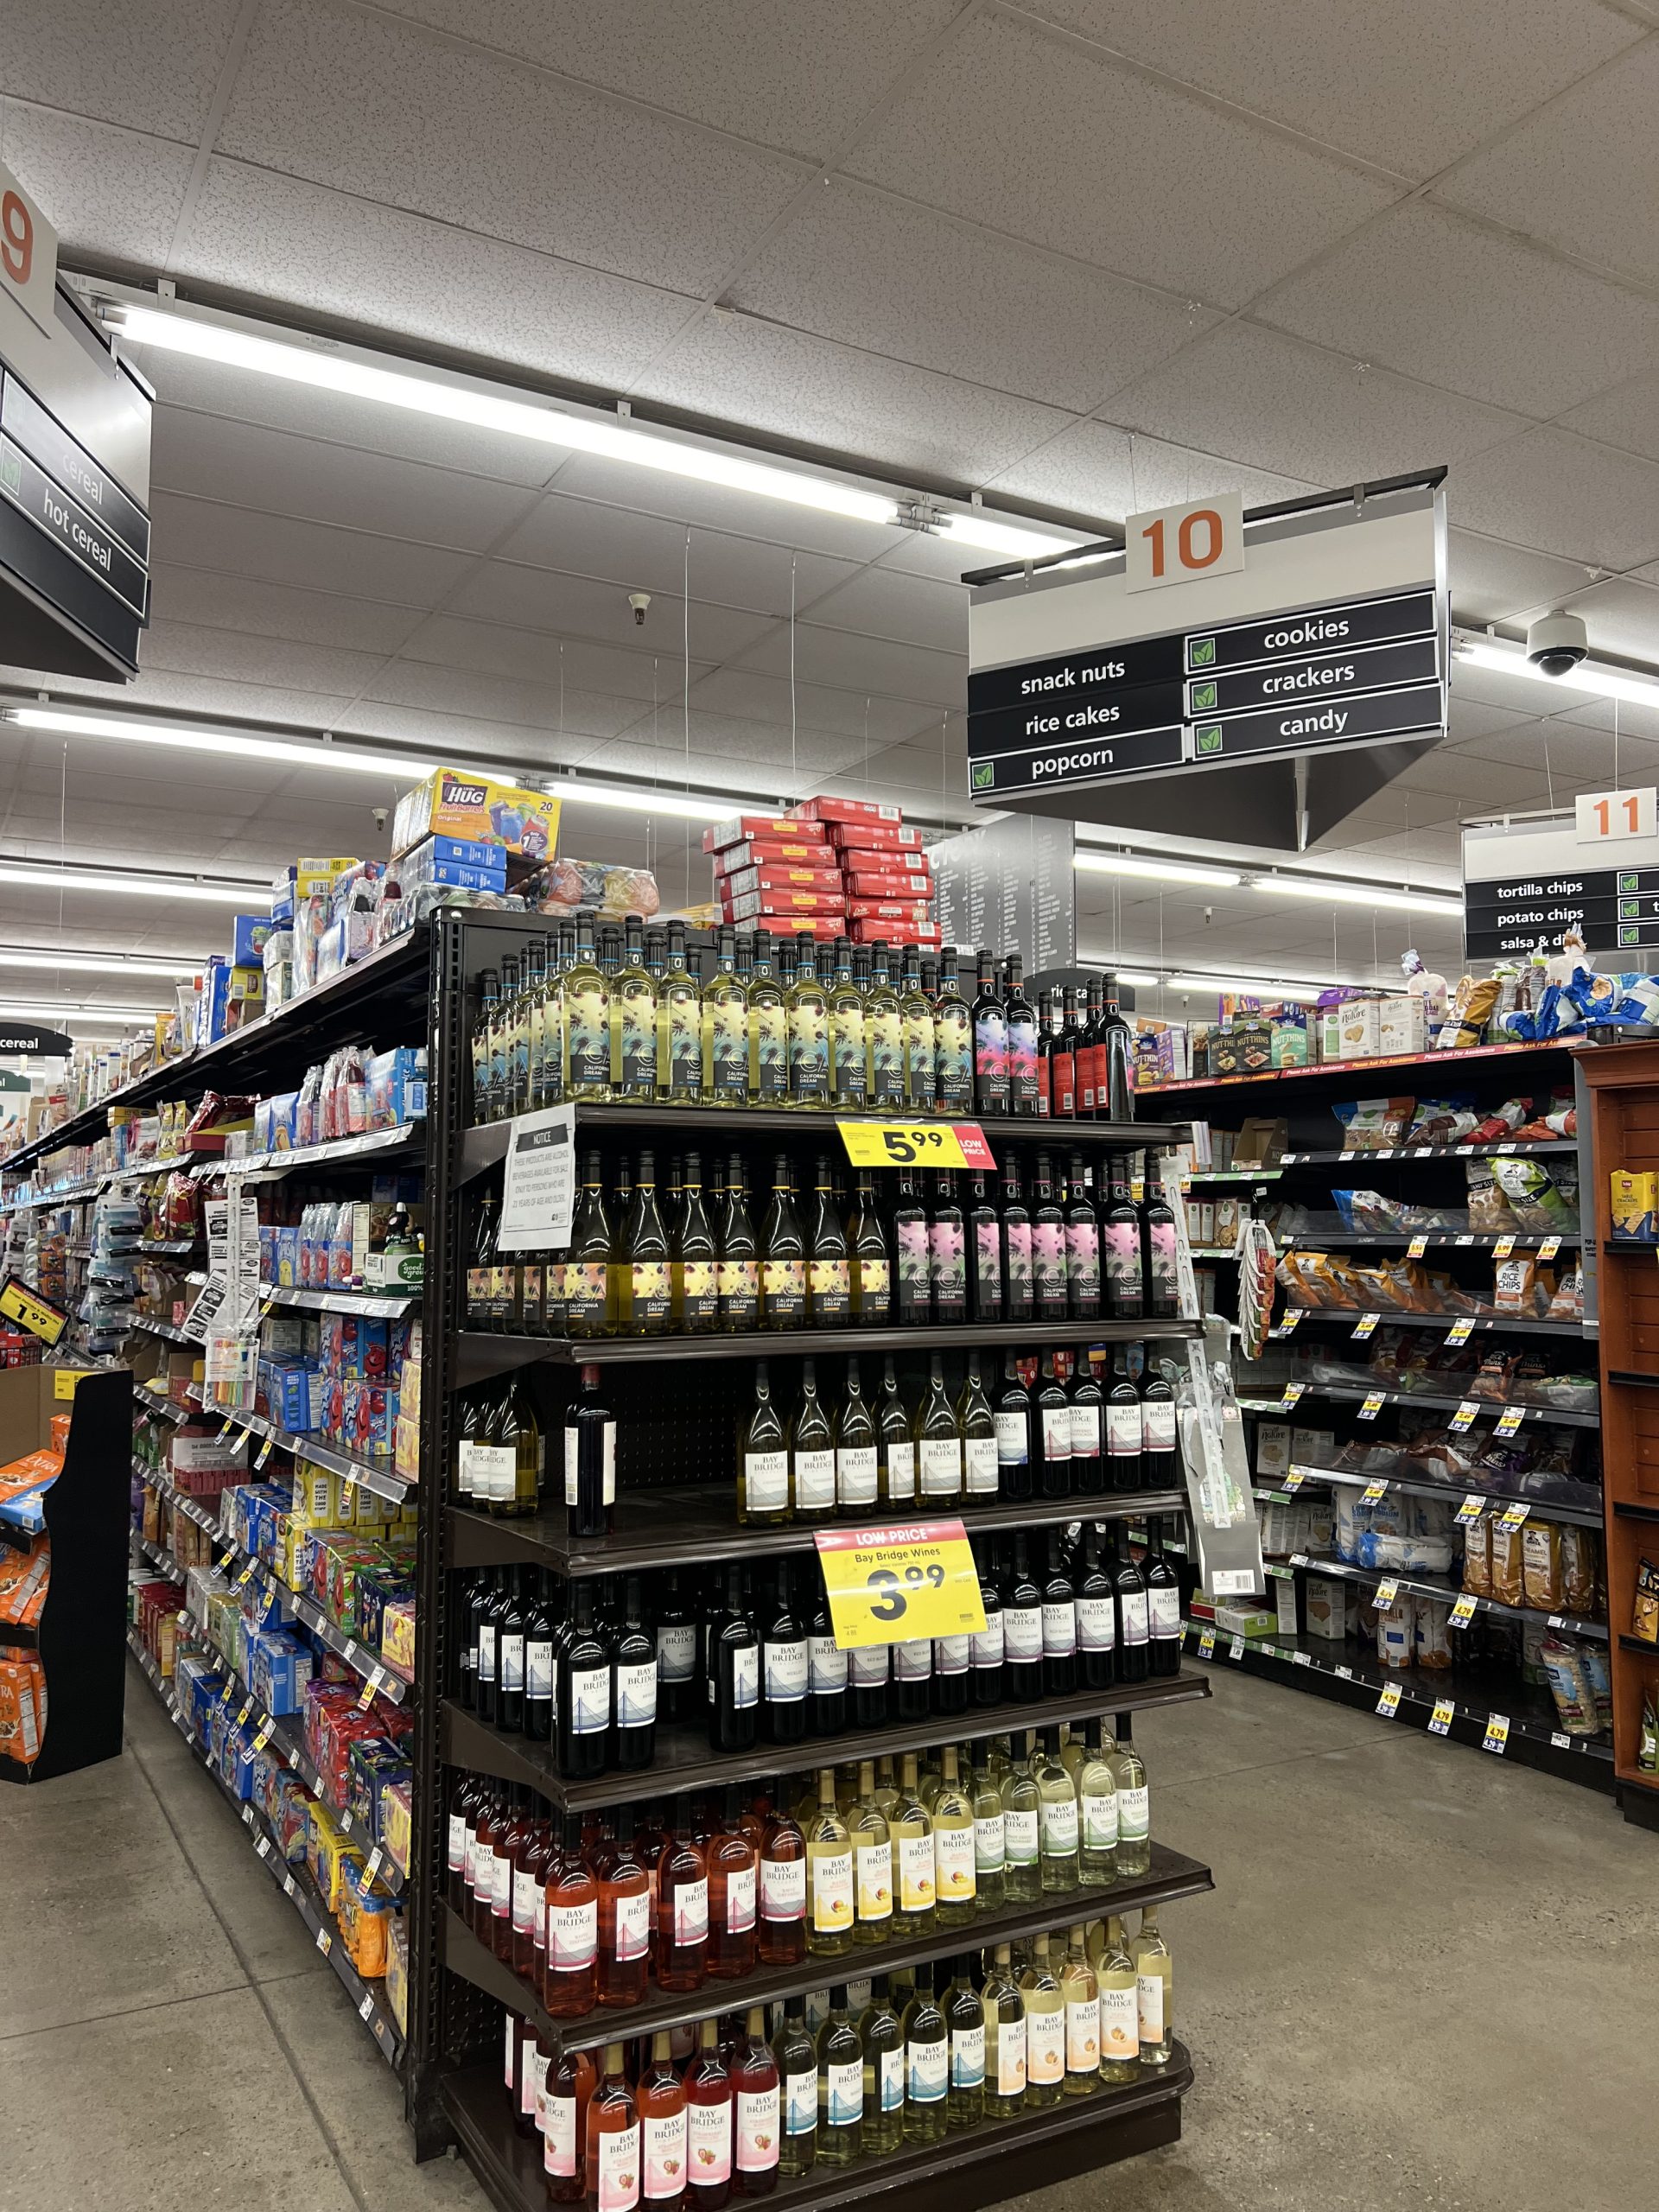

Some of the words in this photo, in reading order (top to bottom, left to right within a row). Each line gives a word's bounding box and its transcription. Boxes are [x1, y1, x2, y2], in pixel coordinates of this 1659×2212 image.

[1, 189, 33, 285] 9
[63, 454, 103, 505] cereal
[44, 488, 69, 534] hot
[73, 523, 111, 572] cereal
[1142, 509, 1223, 577] 10
[1264, 618, 1349, 649] cookies
[1021, 667, 1075, 695] snack
[1082, 659, 1125, 684] nuts
[1262, 664, 1355, 694] crackers
[1026, 714, 1060, 734] rice
[1065, 704, 1120, 728] cakes
[1280, 710, 1348, 740] candy
[1032, 747, 1113, 779] popcorn
[448, 786, 484, 804] HUG
[540, 802, 553, 811] 20
[1593, 796, 1638, 835] 11
[1497, 883, 1543, 899] tortilla
[1547, 880, 1583, 896] chips
[1497, 912, 1544, 927] potato
[1548, 908, 1584, 923] chips
[1500, 935, 1535, 950] salsa
[1538, 936, 1549, 947] &
[0, 1038, 39, 1049] cereal
[1464, 1047, 1496, 1056] Assistance
[533, 1131, 551, 1145] NOTICE
[959, 1140, 982, 1148] LOW
[1522, 1194, 1536, 1204] SIZE
[1498, 1281, 1521, 1289] CHIPS
[846, 1458, 875, 1466] BRIDGE
[856, 1531, 886, 1546] LOW
[889, 1528, 928, 1542] PRICE
[855, 1554, 873, 1563] Bay
[876, 1550, 908, 1561] Bridge
[911, 1548, 941, 1557] Wines
[1456, 1607, 1471, 1616] 4.79
[772, 1653, 804, 1662] BRIDGE
[1435, 1711, 1450, 1720] 4.79
[1490, 1728, 1504, 1738] 4.79
[1122, 1796, 1147, 1805] BRIDGE
[1048, 1811, 1075, 1820] BRIDGE
[943, 1839, 971, 1847] BRIDGE
[831, 1859, 846, 1868] BAY
[766, 1872, 799, 1880] BRIDGE
[823, 1866, 850, 1876] BRIDGE
[566, 1910, 583, 1918] BAY
[557, 1916, 592, 1927] BRIDGE
[1103, 1999, 1133, 2007] BRIDGE
[1037, 2022, 1063, 2031] BRIDGE
[917, 2052, 945, 2062] BRIDGE
[755, 2095, 772, 2105] BAY
[747, 2102, 777, 2113] BRIDGE
[664, 2120, 679, 2131] BAY
[690, 2117, 724, 2126] BRIDGE
[655, 2126, 684, 2139] BRIDGE
